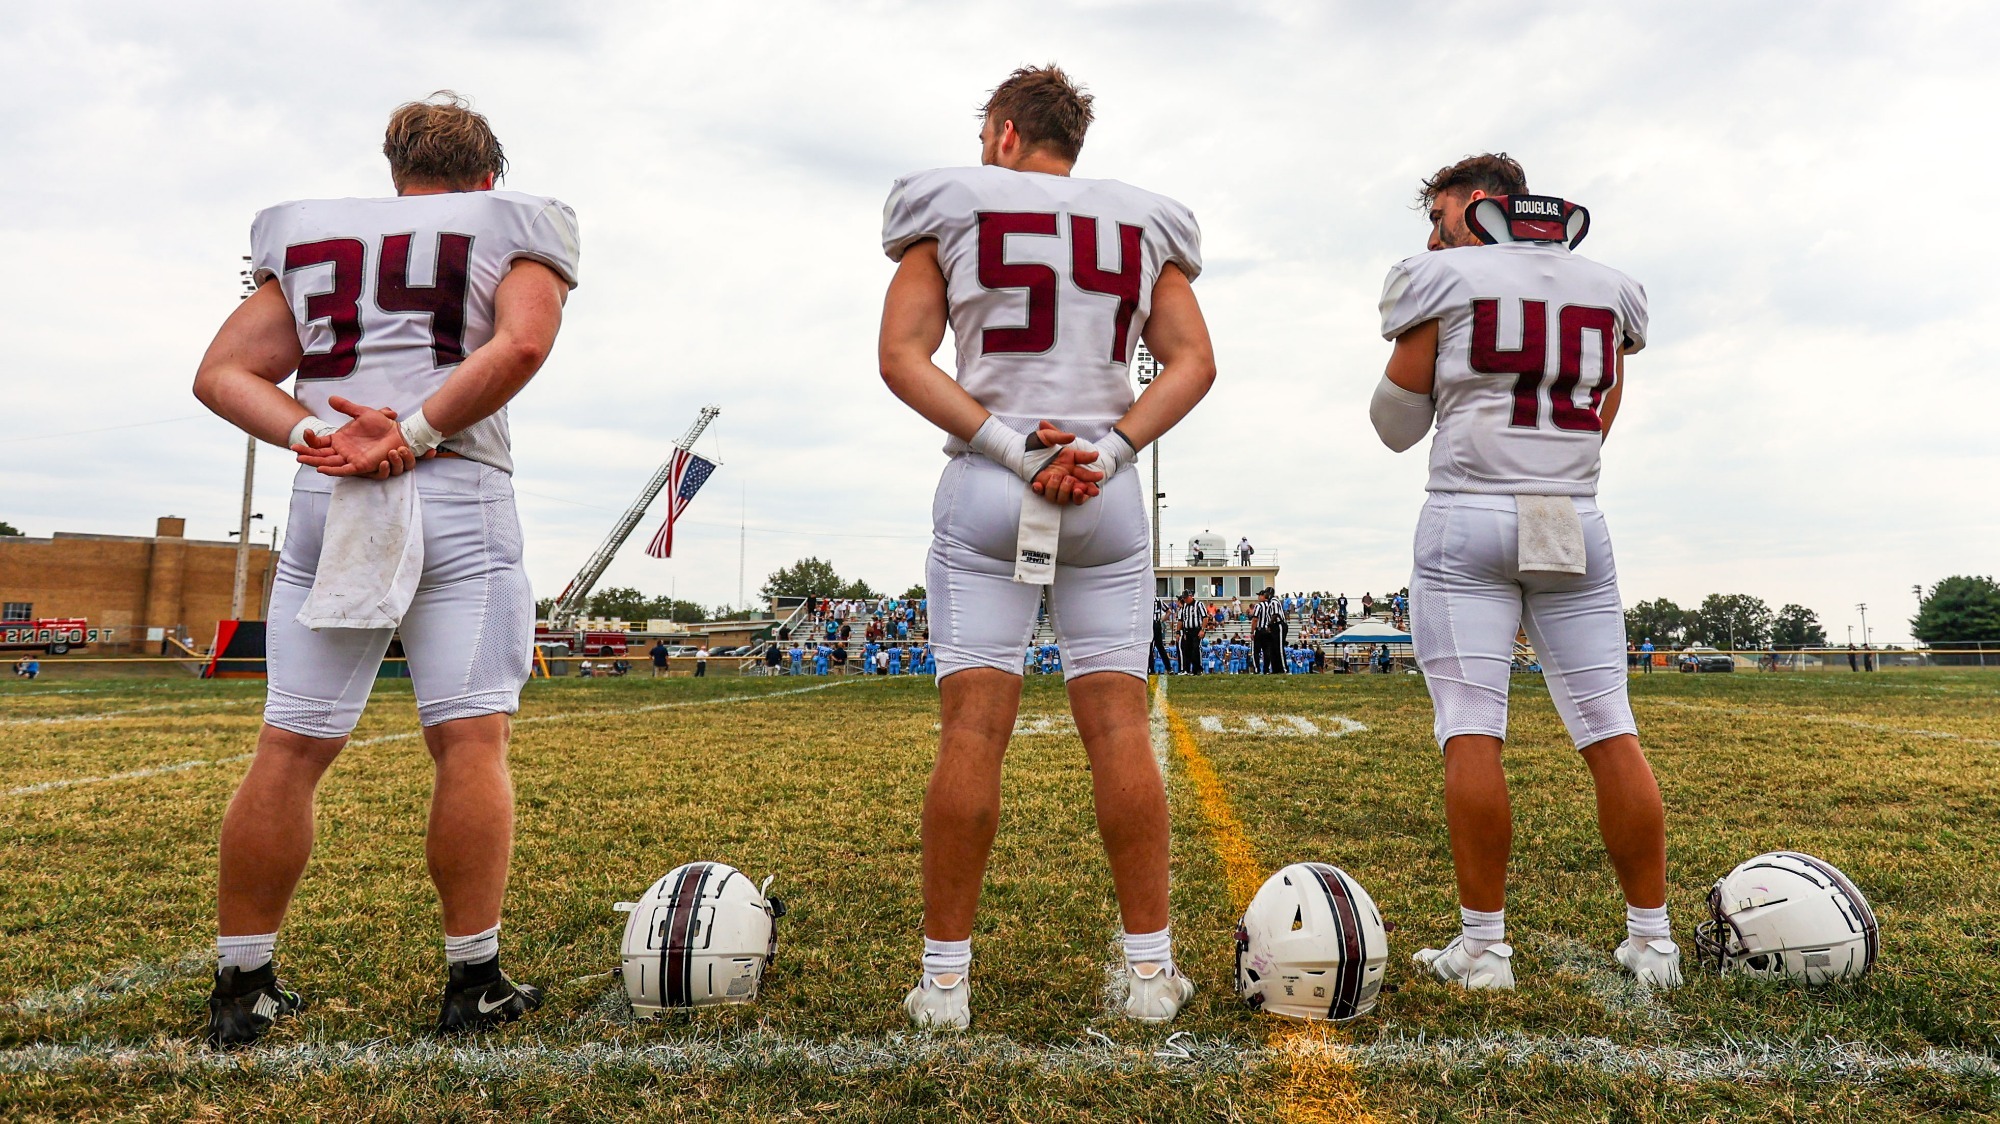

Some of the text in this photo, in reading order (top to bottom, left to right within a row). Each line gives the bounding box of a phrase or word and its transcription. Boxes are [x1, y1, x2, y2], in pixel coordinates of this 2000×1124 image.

[1515, 200, 1559, 216] DOUGLAS
[283, 231, 476, 383] 34
[973, 210, 1146, 367] 54
[1467, 297, 1618, 434] 40
[252, 993, 280, 1021] NIKE
